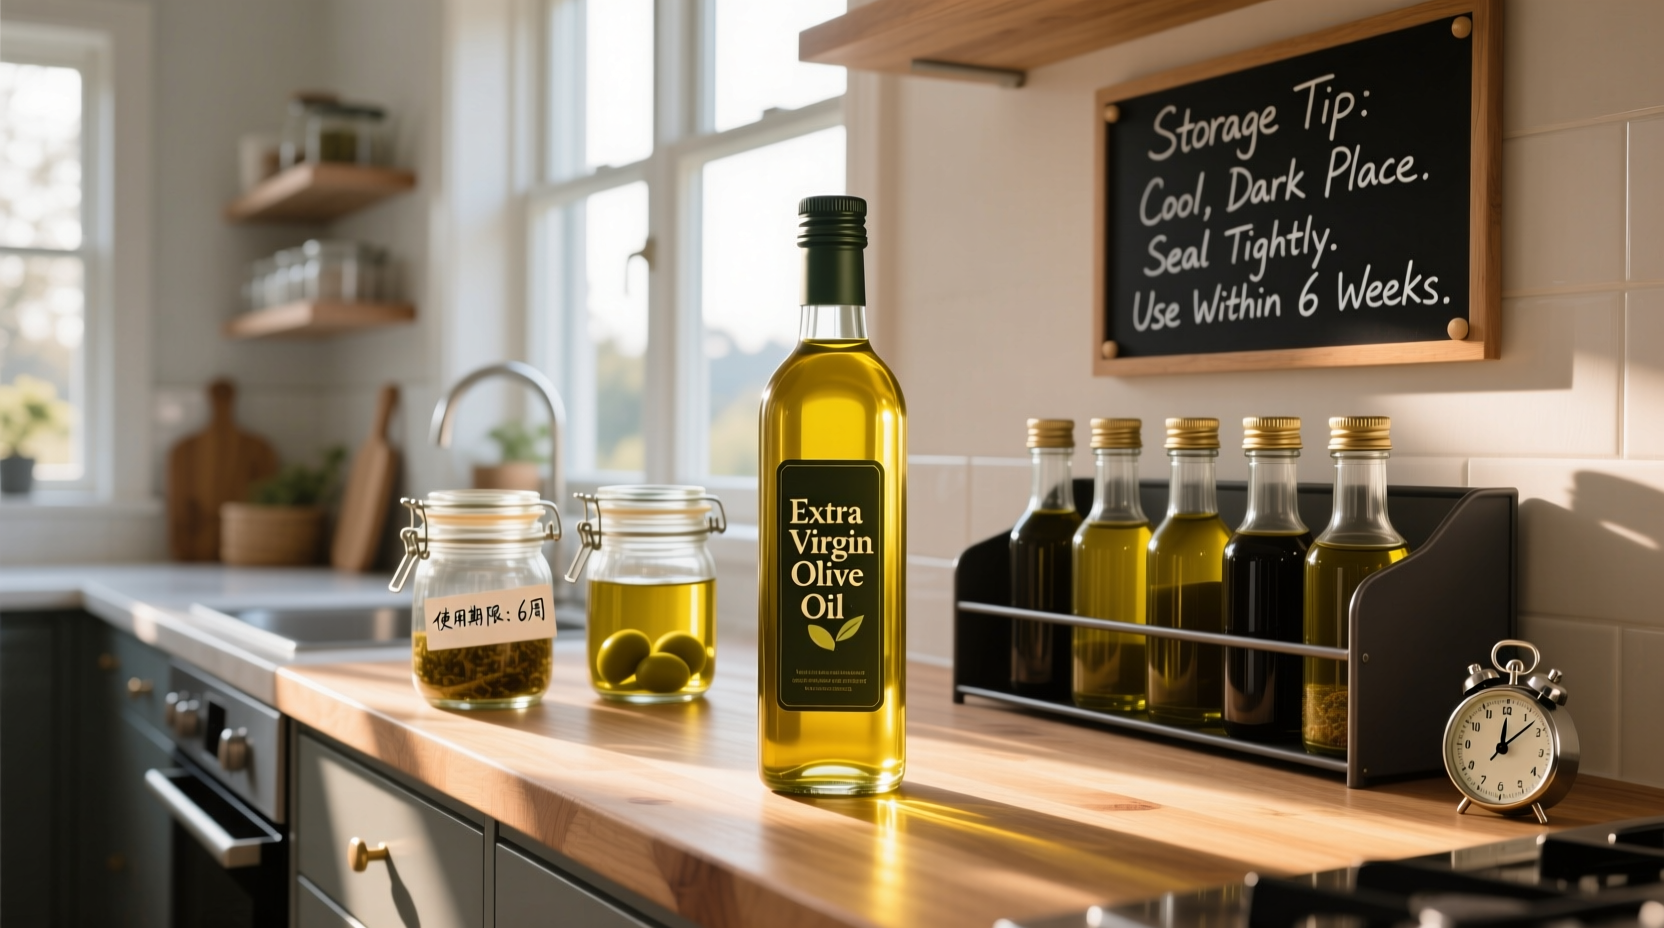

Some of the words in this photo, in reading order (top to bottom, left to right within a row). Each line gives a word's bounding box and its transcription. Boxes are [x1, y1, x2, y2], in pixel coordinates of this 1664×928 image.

[1148, 104, 1279, 161] Storage
[1293, 73, 1370, 141] Tip:
[1139, 171, 1212, 226] Cool,
[1226, 157, 1306, 213] Dark
[1324, 144, 1429, 199] Place.
[1143, 228, 1210, 277] Seal
[1224, 214, 1338, 282] Tightly.
[1132, 289, 1181, 331] Use
[1193, 282, 1281, 324] Within
[1298, 271, 1319, 317] 6
[1338, 259, 1450, 311] Weeks.
[790, 498, 863, 524] Extra
[789, 529, 874, 562] Virgin
[791, 560, 864, 587] Olive
[801, 593, 844, 620] Oil
